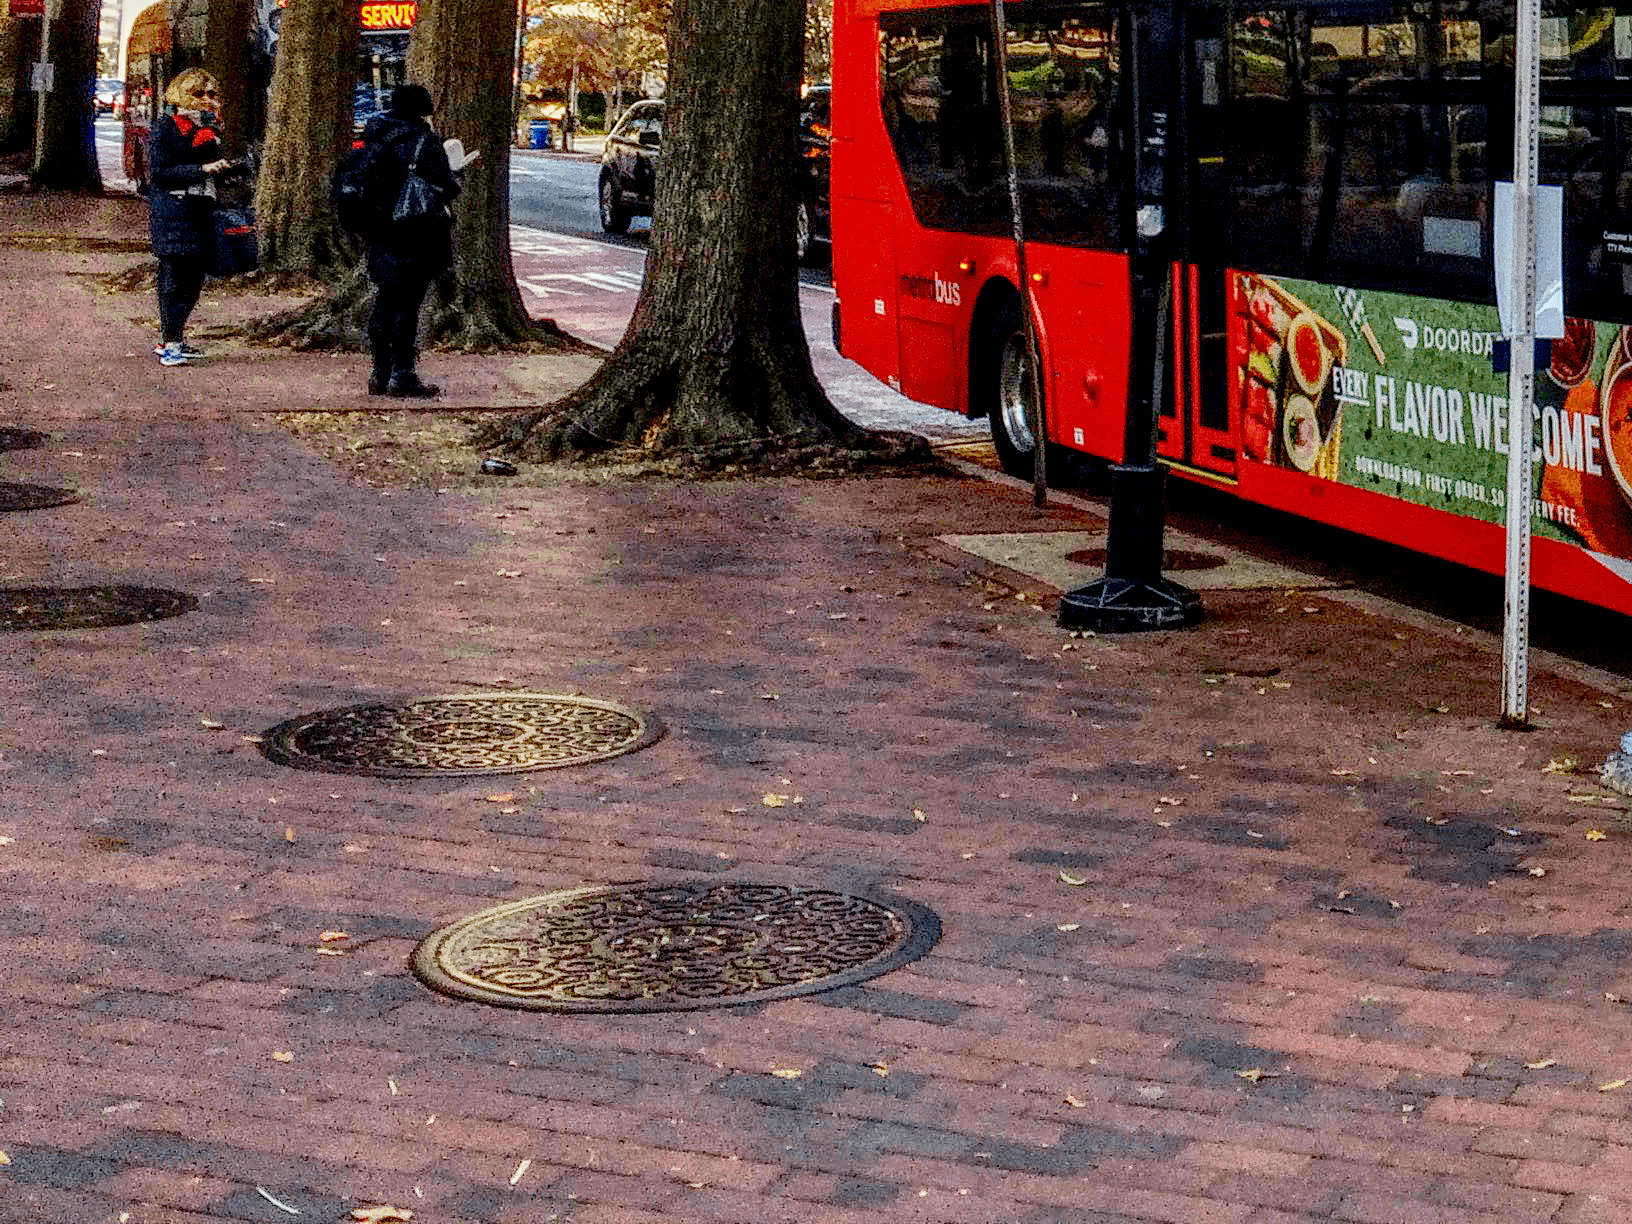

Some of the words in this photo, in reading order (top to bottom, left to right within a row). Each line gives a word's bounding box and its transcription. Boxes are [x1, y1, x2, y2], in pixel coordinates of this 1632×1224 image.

[361, 3, 417, 27] SERVI
[1423, 326, 1494, 358] DOORDA
[1332, 365, 1369, 399] EVERY
[1374, 374, 1465, 446] FLAVOR
[1469, 390, 1603, 476] WECOME
[1355, 454, 1401, 482] DOWNLOAD
[1425, 473, 1452, 495] FIRST
